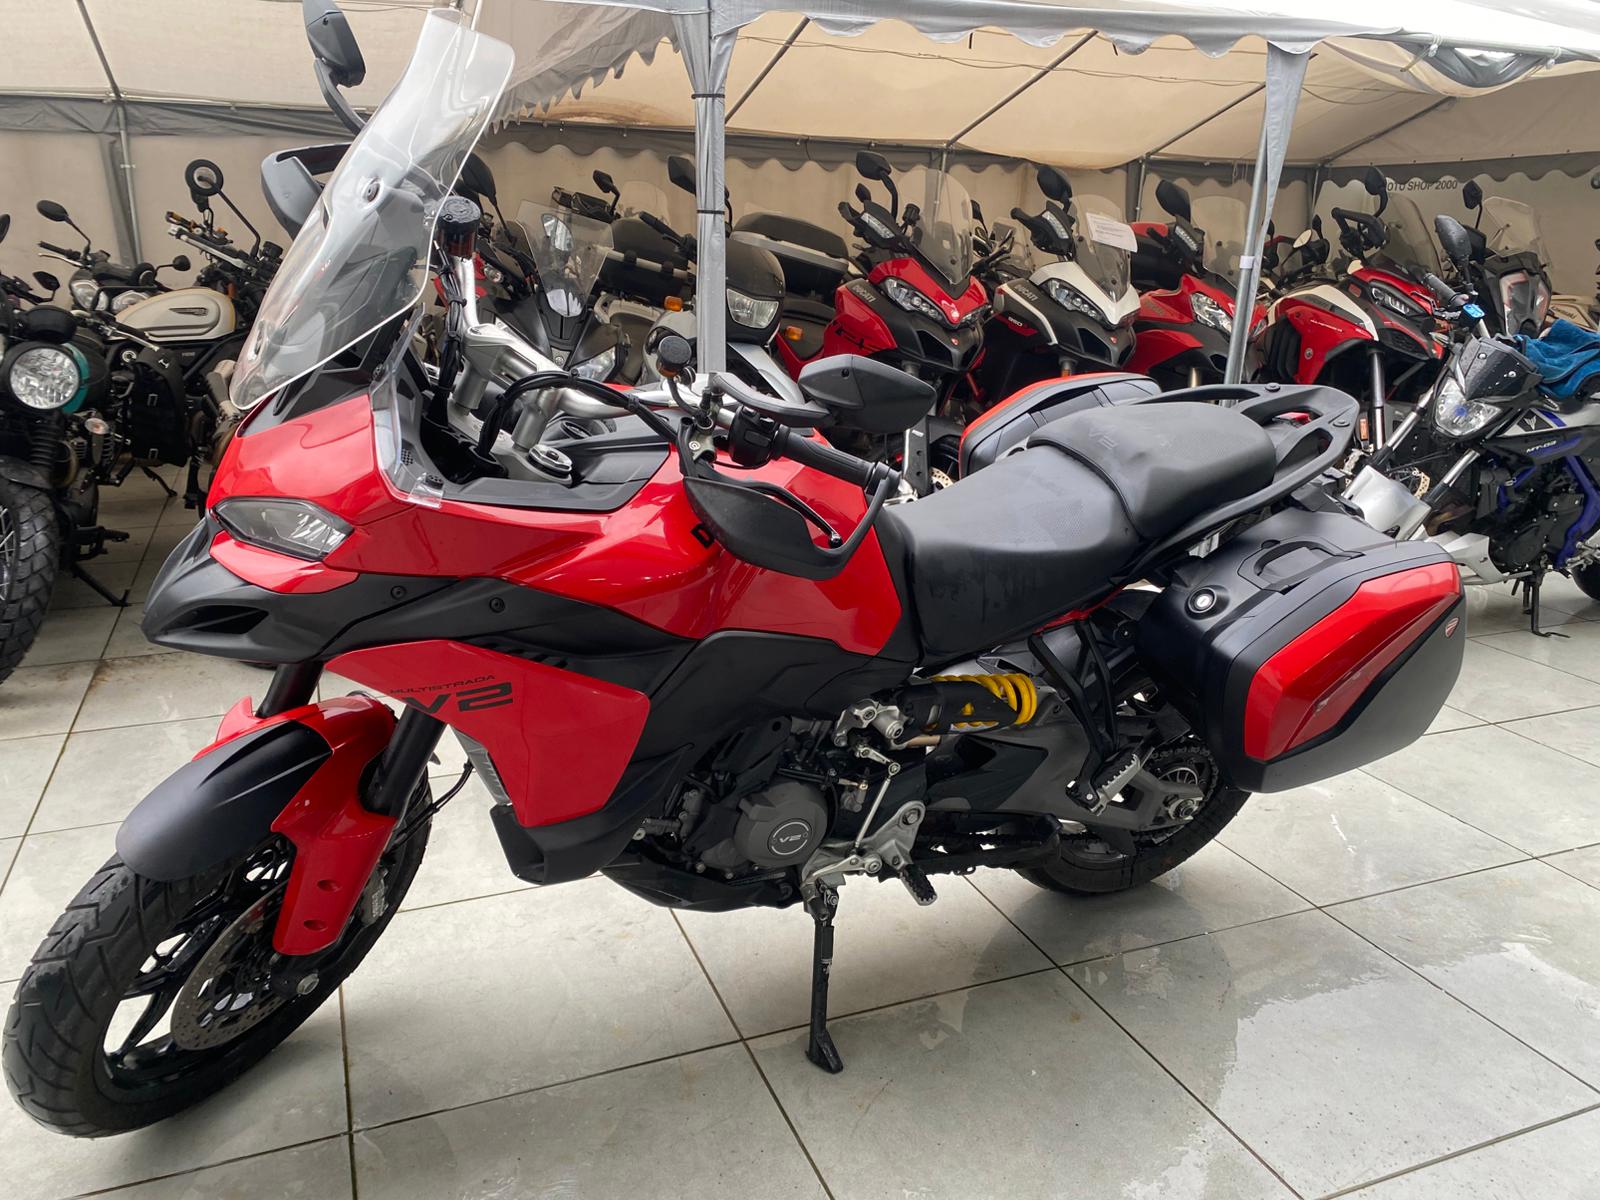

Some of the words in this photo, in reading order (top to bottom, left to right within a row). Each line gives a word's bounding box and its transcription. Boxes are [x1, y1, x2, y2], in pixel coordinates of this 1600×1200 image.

[1435, 180, 1458, 190] 2000
[390, 674, 496, 693] MULTISTRADA
[403, 681, 513, 713] V2
[779, 834, 802, 843] V2
